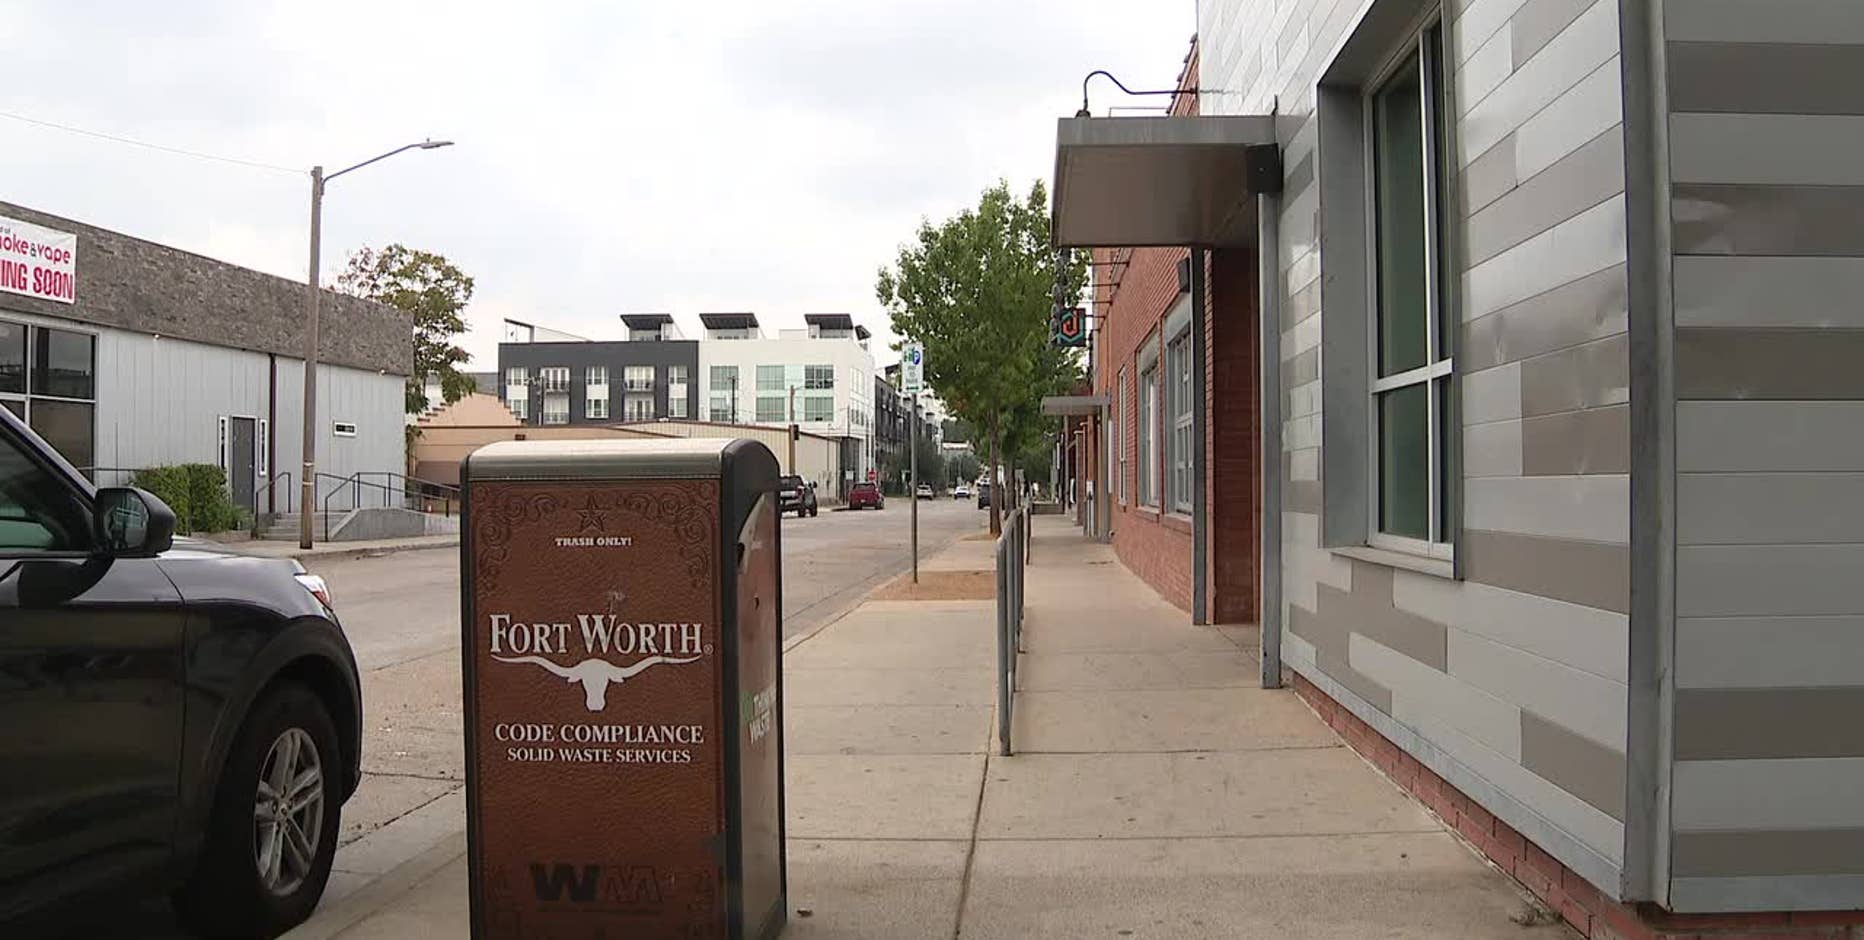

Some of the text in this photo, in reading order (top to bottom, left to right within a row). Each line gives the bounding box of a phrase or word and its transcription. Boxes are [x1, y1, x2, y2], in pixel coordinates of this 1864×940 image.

[33, 266, 73, 299] SOON
[555, 536, 632, 547] TRASH ONLY!
[495, 723, 704, 744] CODE COMPLIANCE
[507, 747, 691, 764] SOLID WASTE SERVICES
